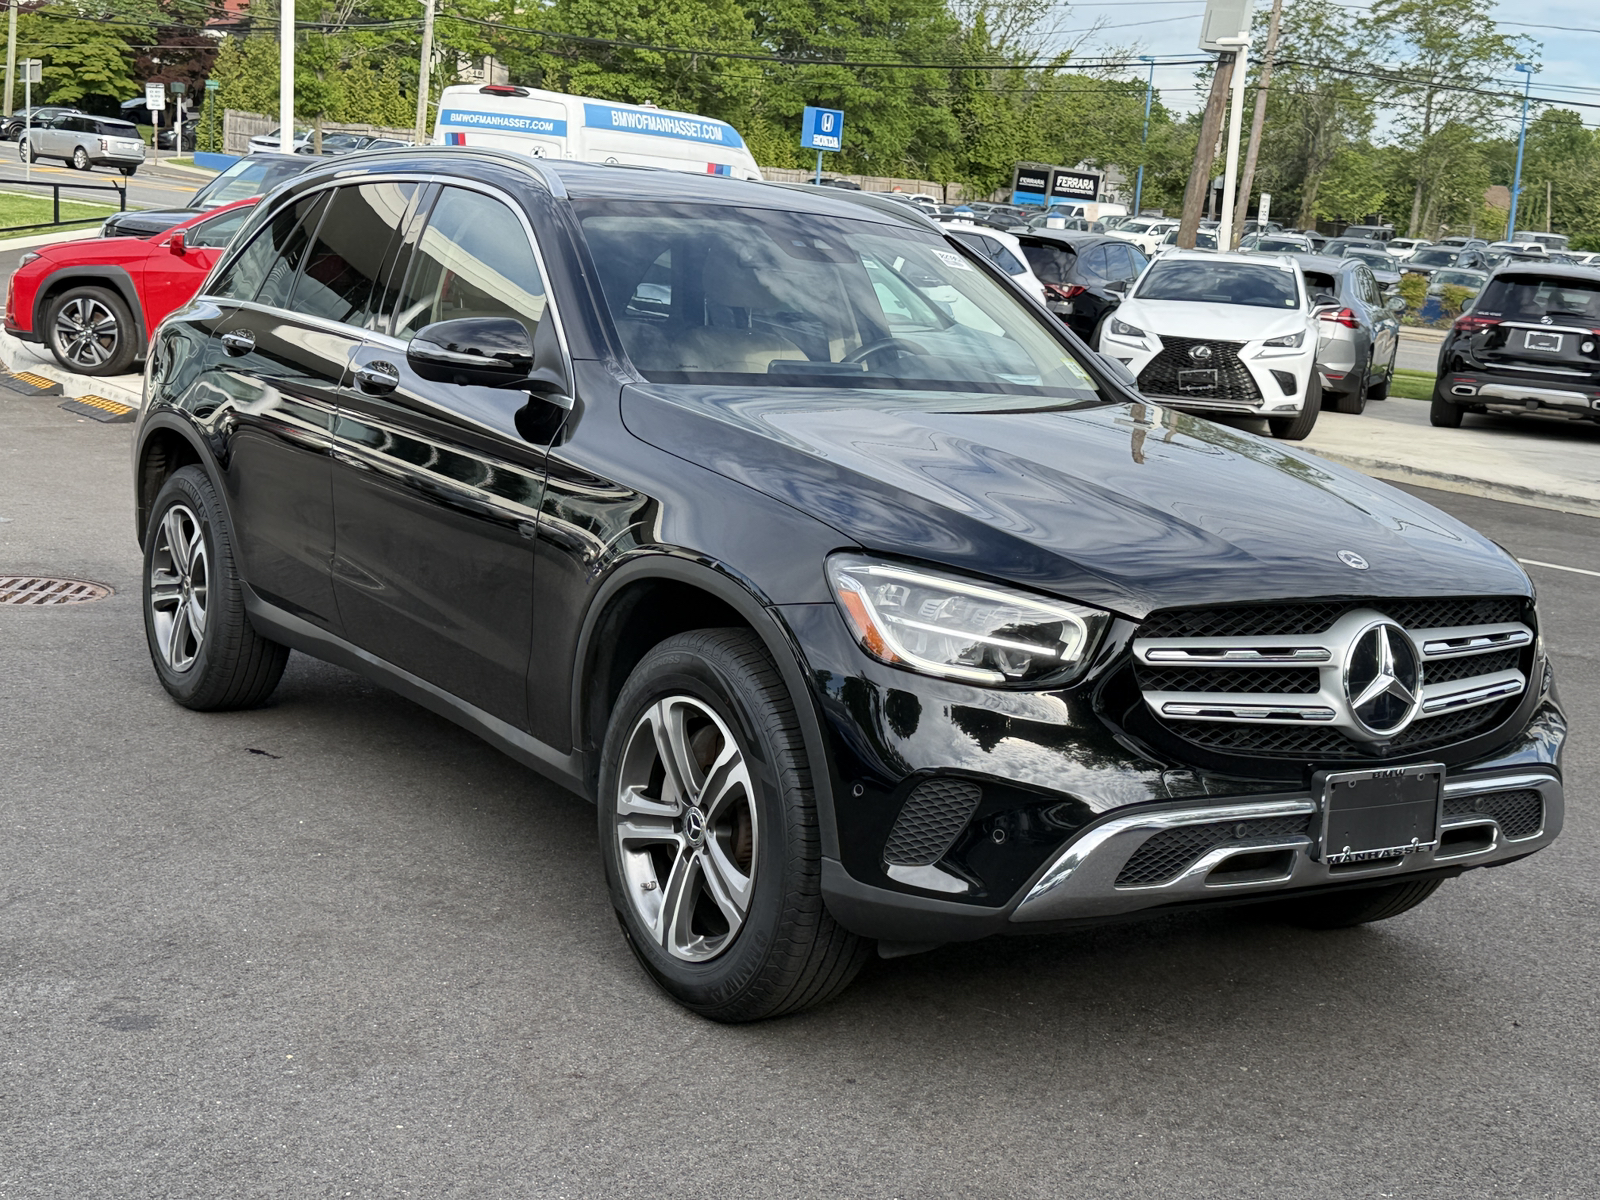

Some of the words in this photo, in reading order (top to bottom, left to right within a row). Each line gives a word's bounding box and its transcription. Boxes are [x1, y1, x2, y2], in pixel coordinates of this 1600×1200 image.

[450, 112, 554, 131] BMWOFMANHASSET.COM
[611, 110, 723, 141] BMWOFMANHASSET.COM
[1056, 175, 1094, 191] FERRARA
[1372, 768, 1407, 779] BMW
[1327, 845, 1435, 864] MANHASSET
